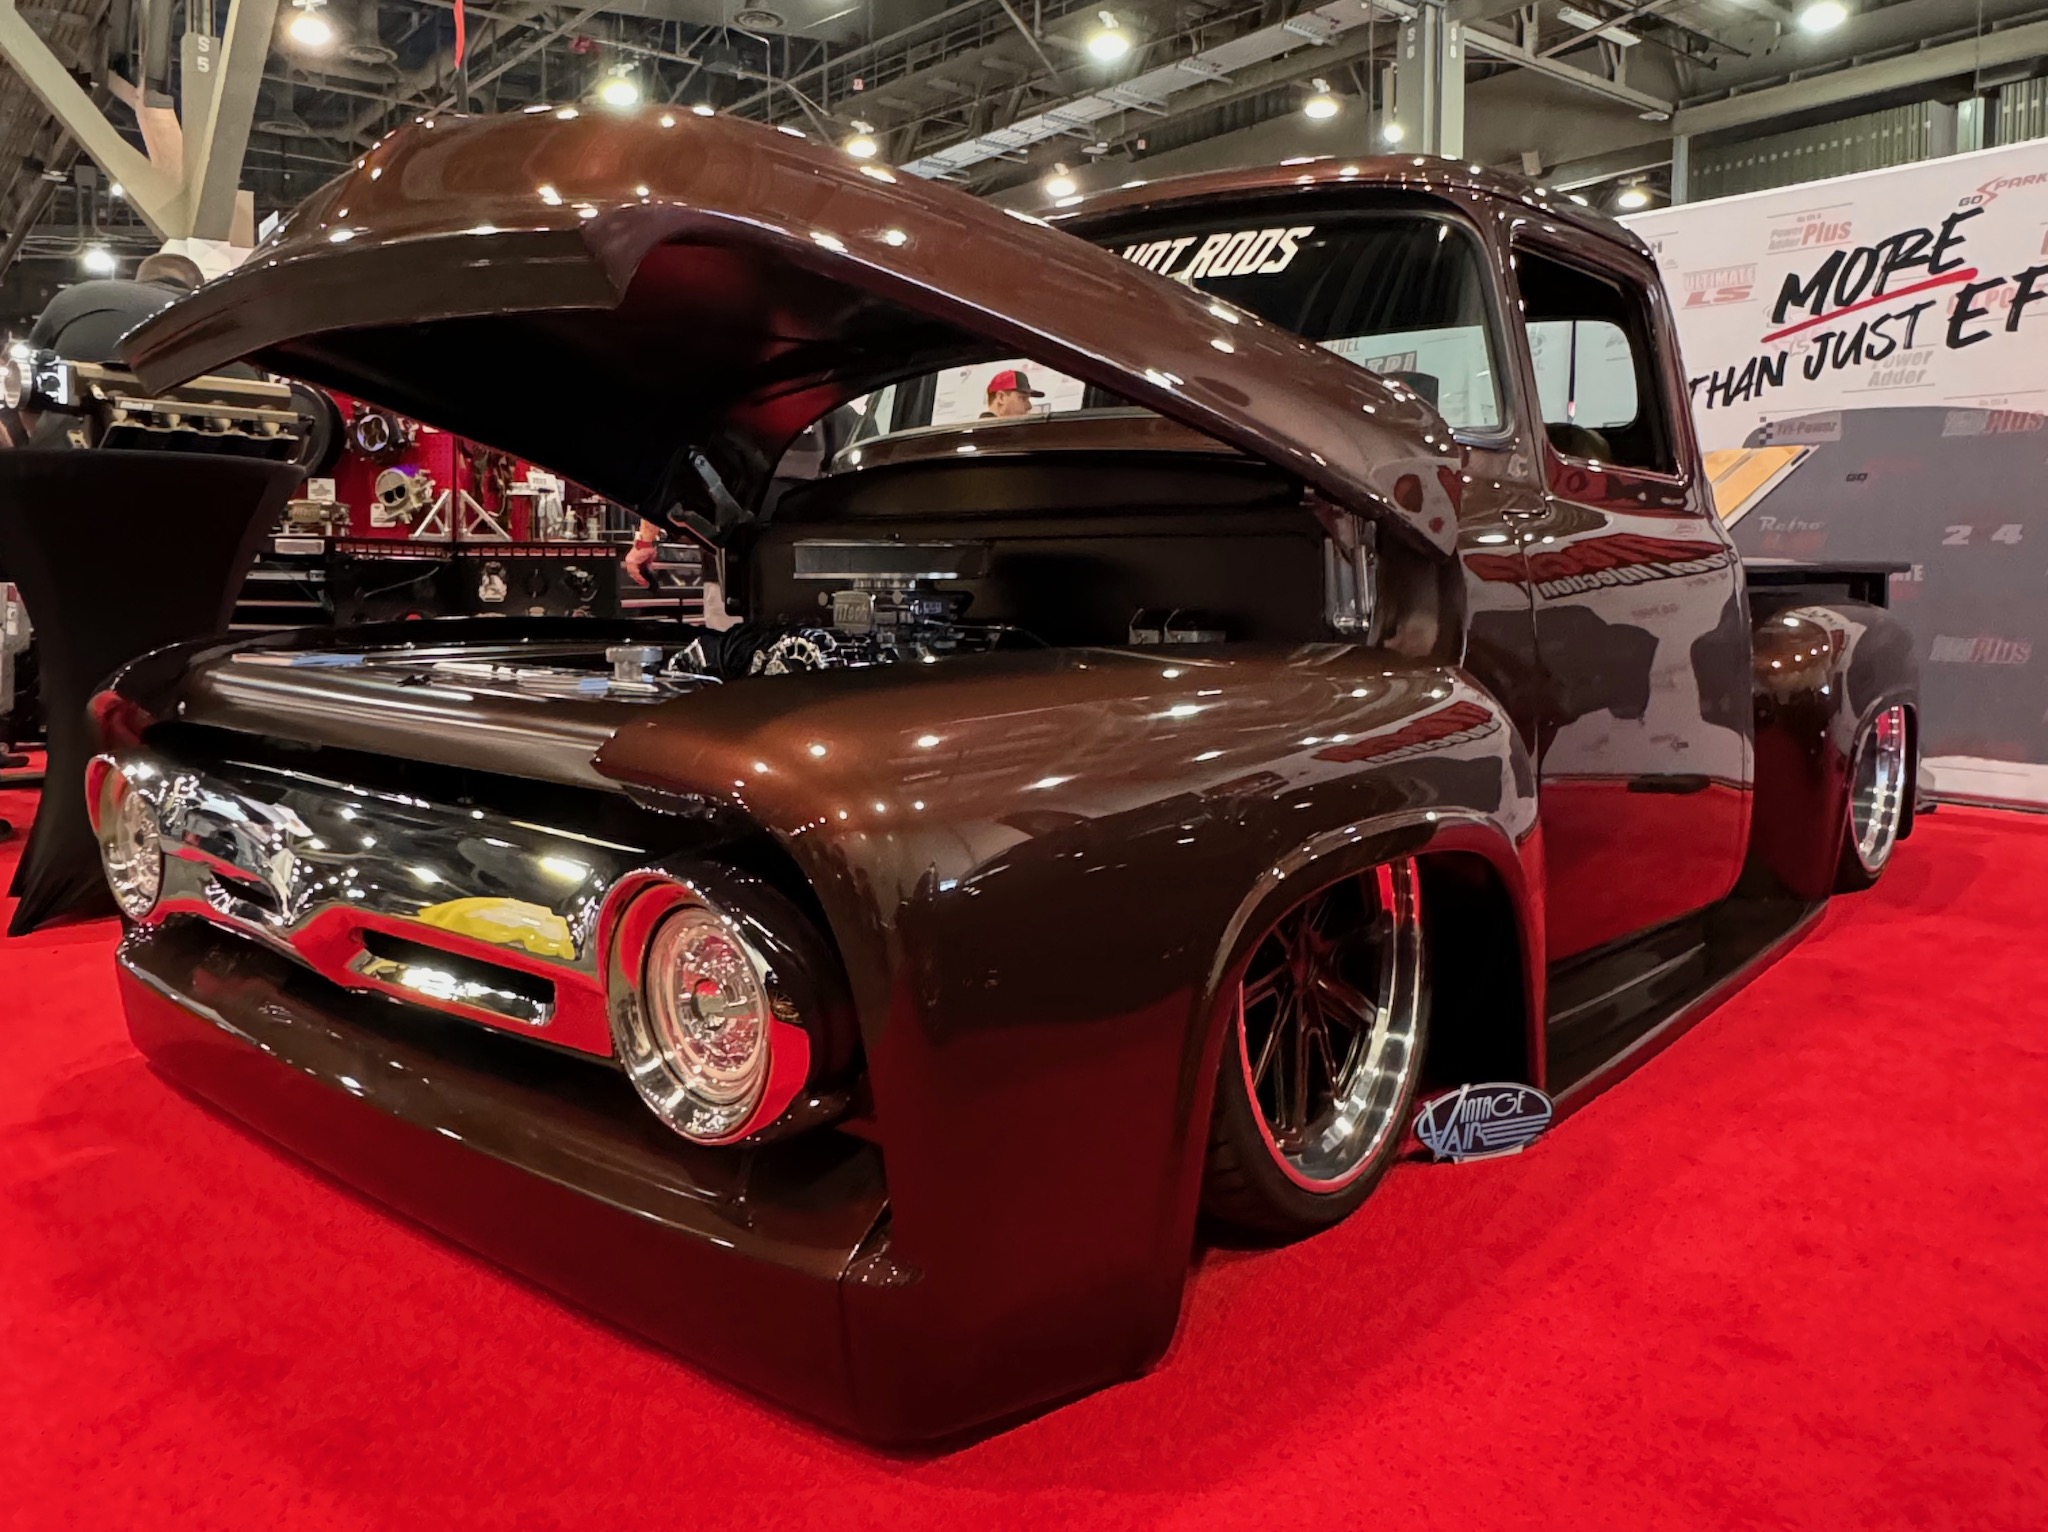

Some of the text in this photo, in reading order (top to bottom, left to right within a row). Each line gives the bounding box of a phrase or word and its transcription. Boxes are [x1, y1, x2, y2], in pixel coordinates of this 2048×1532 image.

[1181, 226, 1316, 280] RODS
[1801, 220, 1853, 246] Plus
[1771, 206, 1985, 324] MORE
[1685, 284, 1754, 307] LS
[1688, 351, 1789, 410] THAN
[1803, 299, 1937, 381] JUST
[1867, 368, 1928, 388] Adder
[1423, 1083, 1526, 1158] VINTAGE
[1444, 1121, 1488, 1161] AIR
